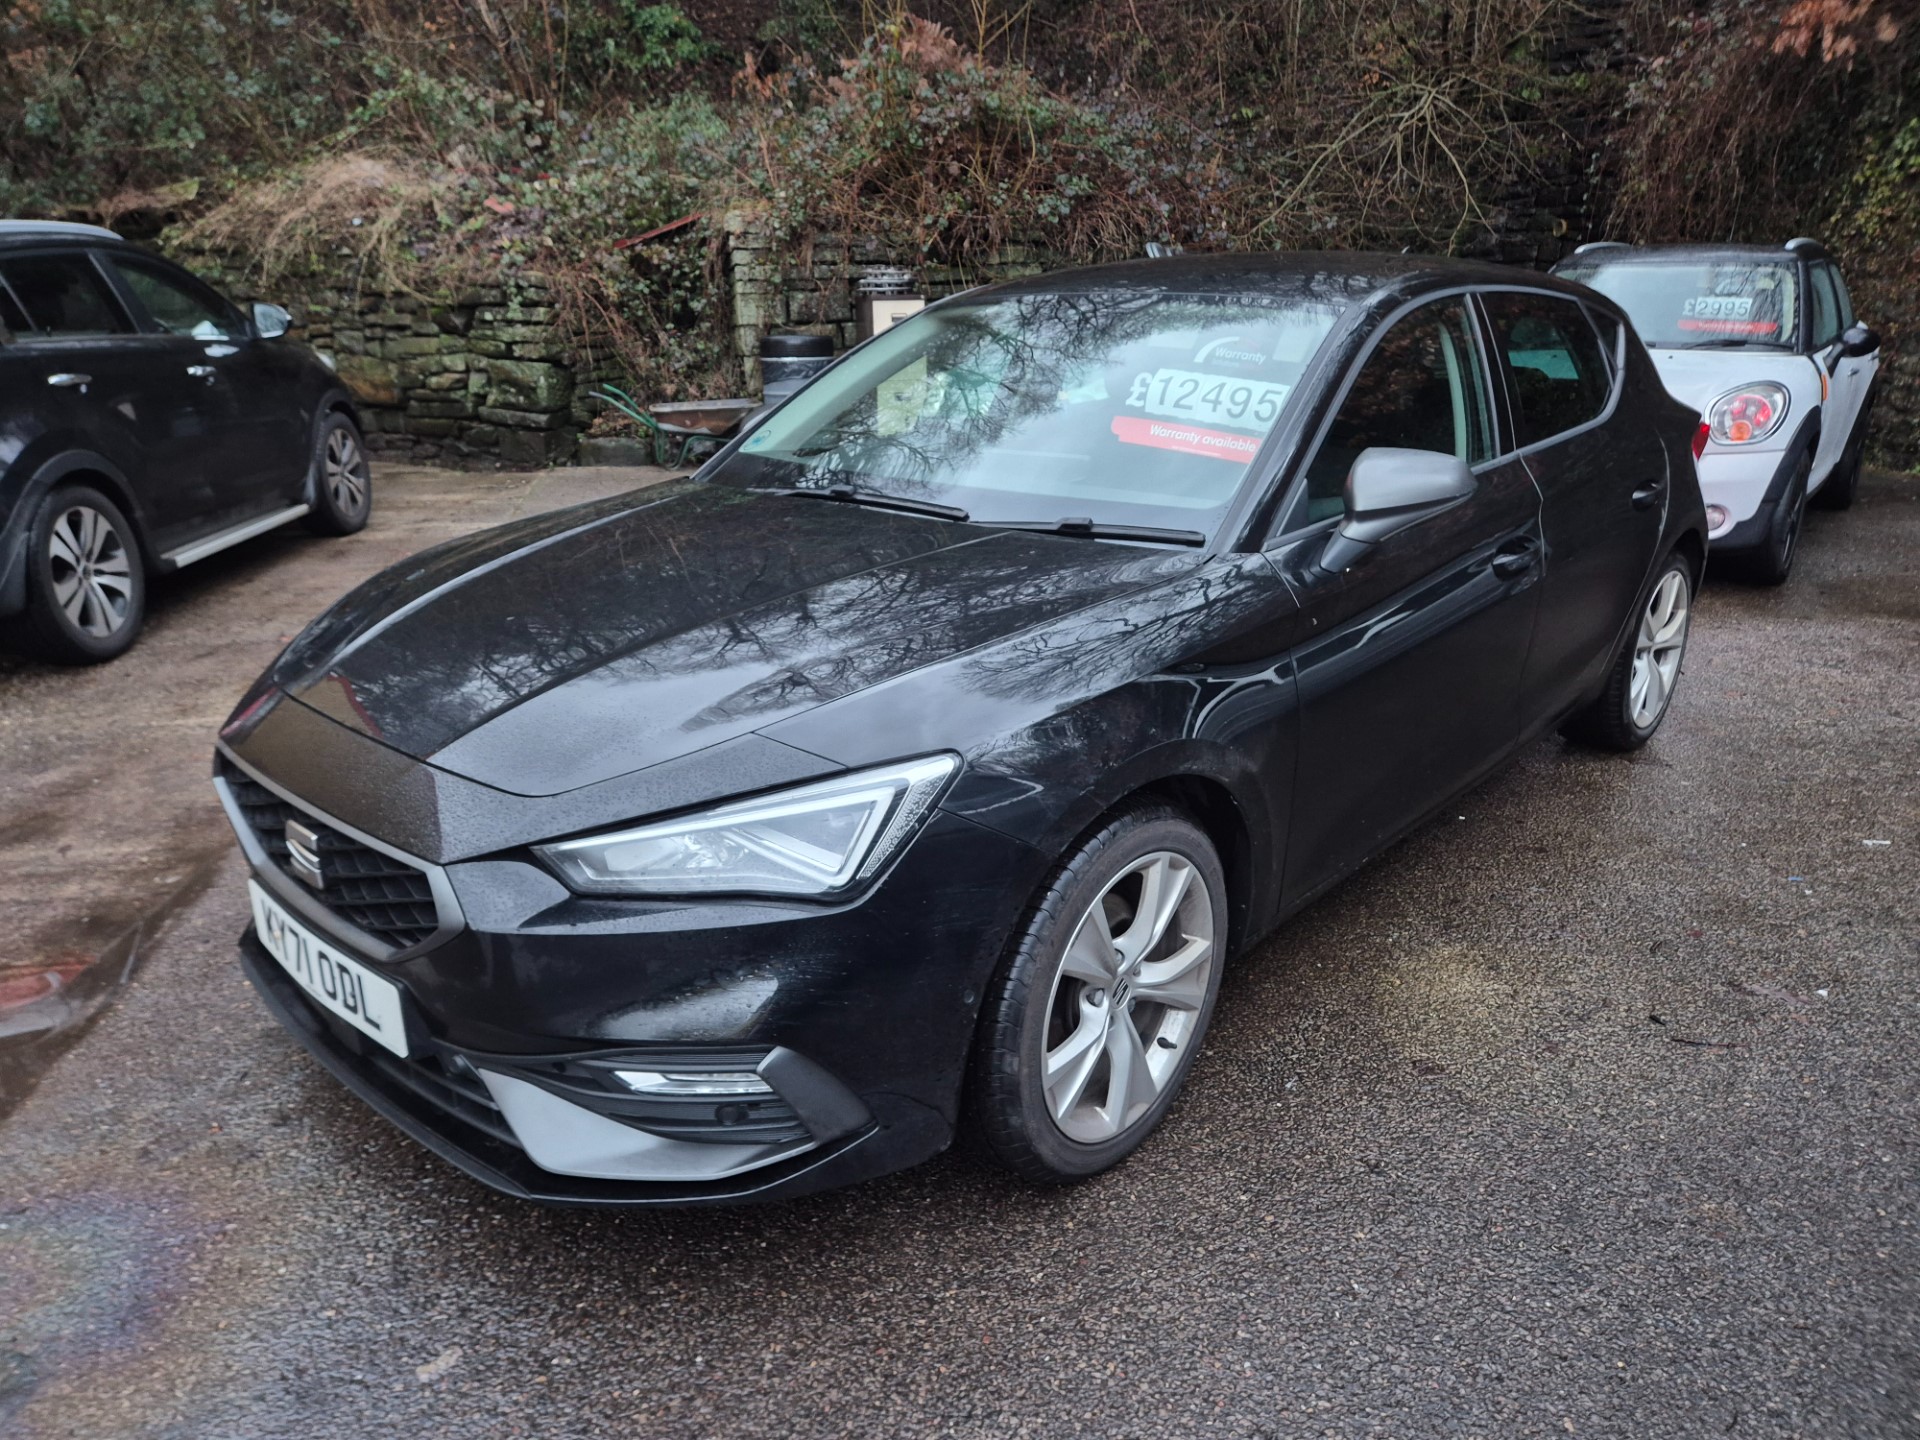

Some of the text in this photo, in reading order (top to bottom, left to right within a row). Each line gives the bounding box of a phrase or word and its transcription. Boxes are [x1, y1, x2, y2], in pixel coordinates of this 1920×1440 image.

[1682, 298, 1749, 317] £2995
[1215, 347, 1267, 366] Warranty
[1126, 372, 1283, 423] £12495
[1150, 424, 1201, 445] Warranty
[1202, 435, 1257, 452] available
